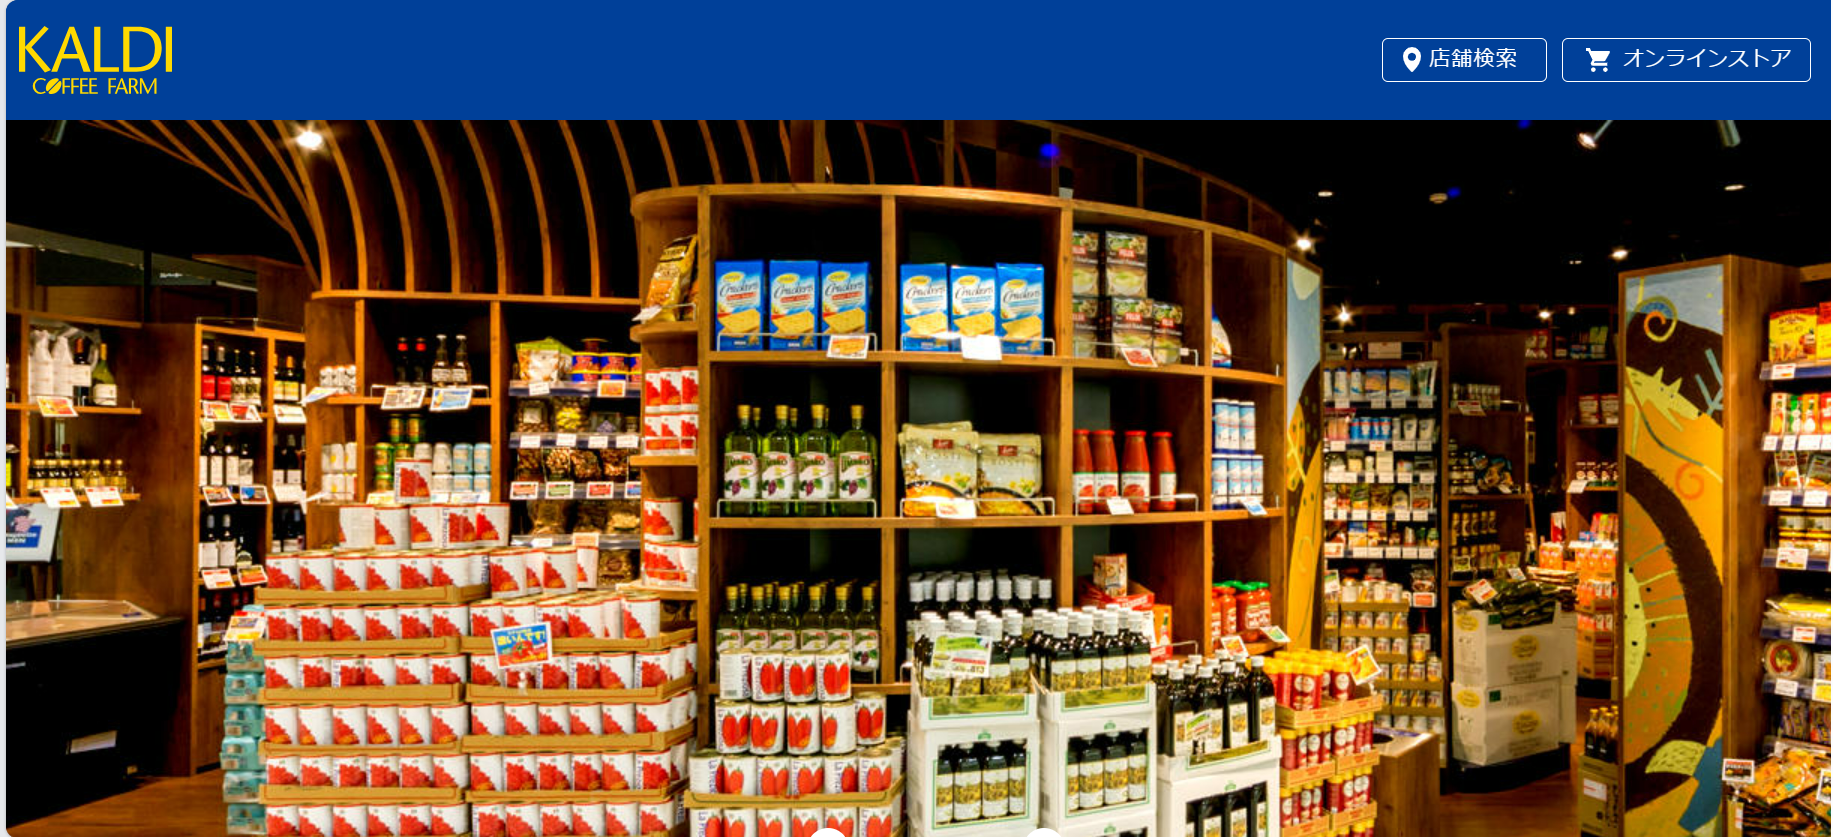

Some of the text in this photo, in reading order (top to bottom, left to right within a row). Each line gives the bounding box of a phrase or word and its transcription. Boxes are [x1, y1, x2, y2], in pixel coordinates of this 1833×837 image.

[719, 280, 759, 297] Crackers
[774, 282, 813, 299] Crackers
[825, 279, 864, 296] Crackers
[906, 285, 945, 300] Crackers
[955, 285, 993, 300] Crackers
[1003, 289, 1040, 304] Crackers
